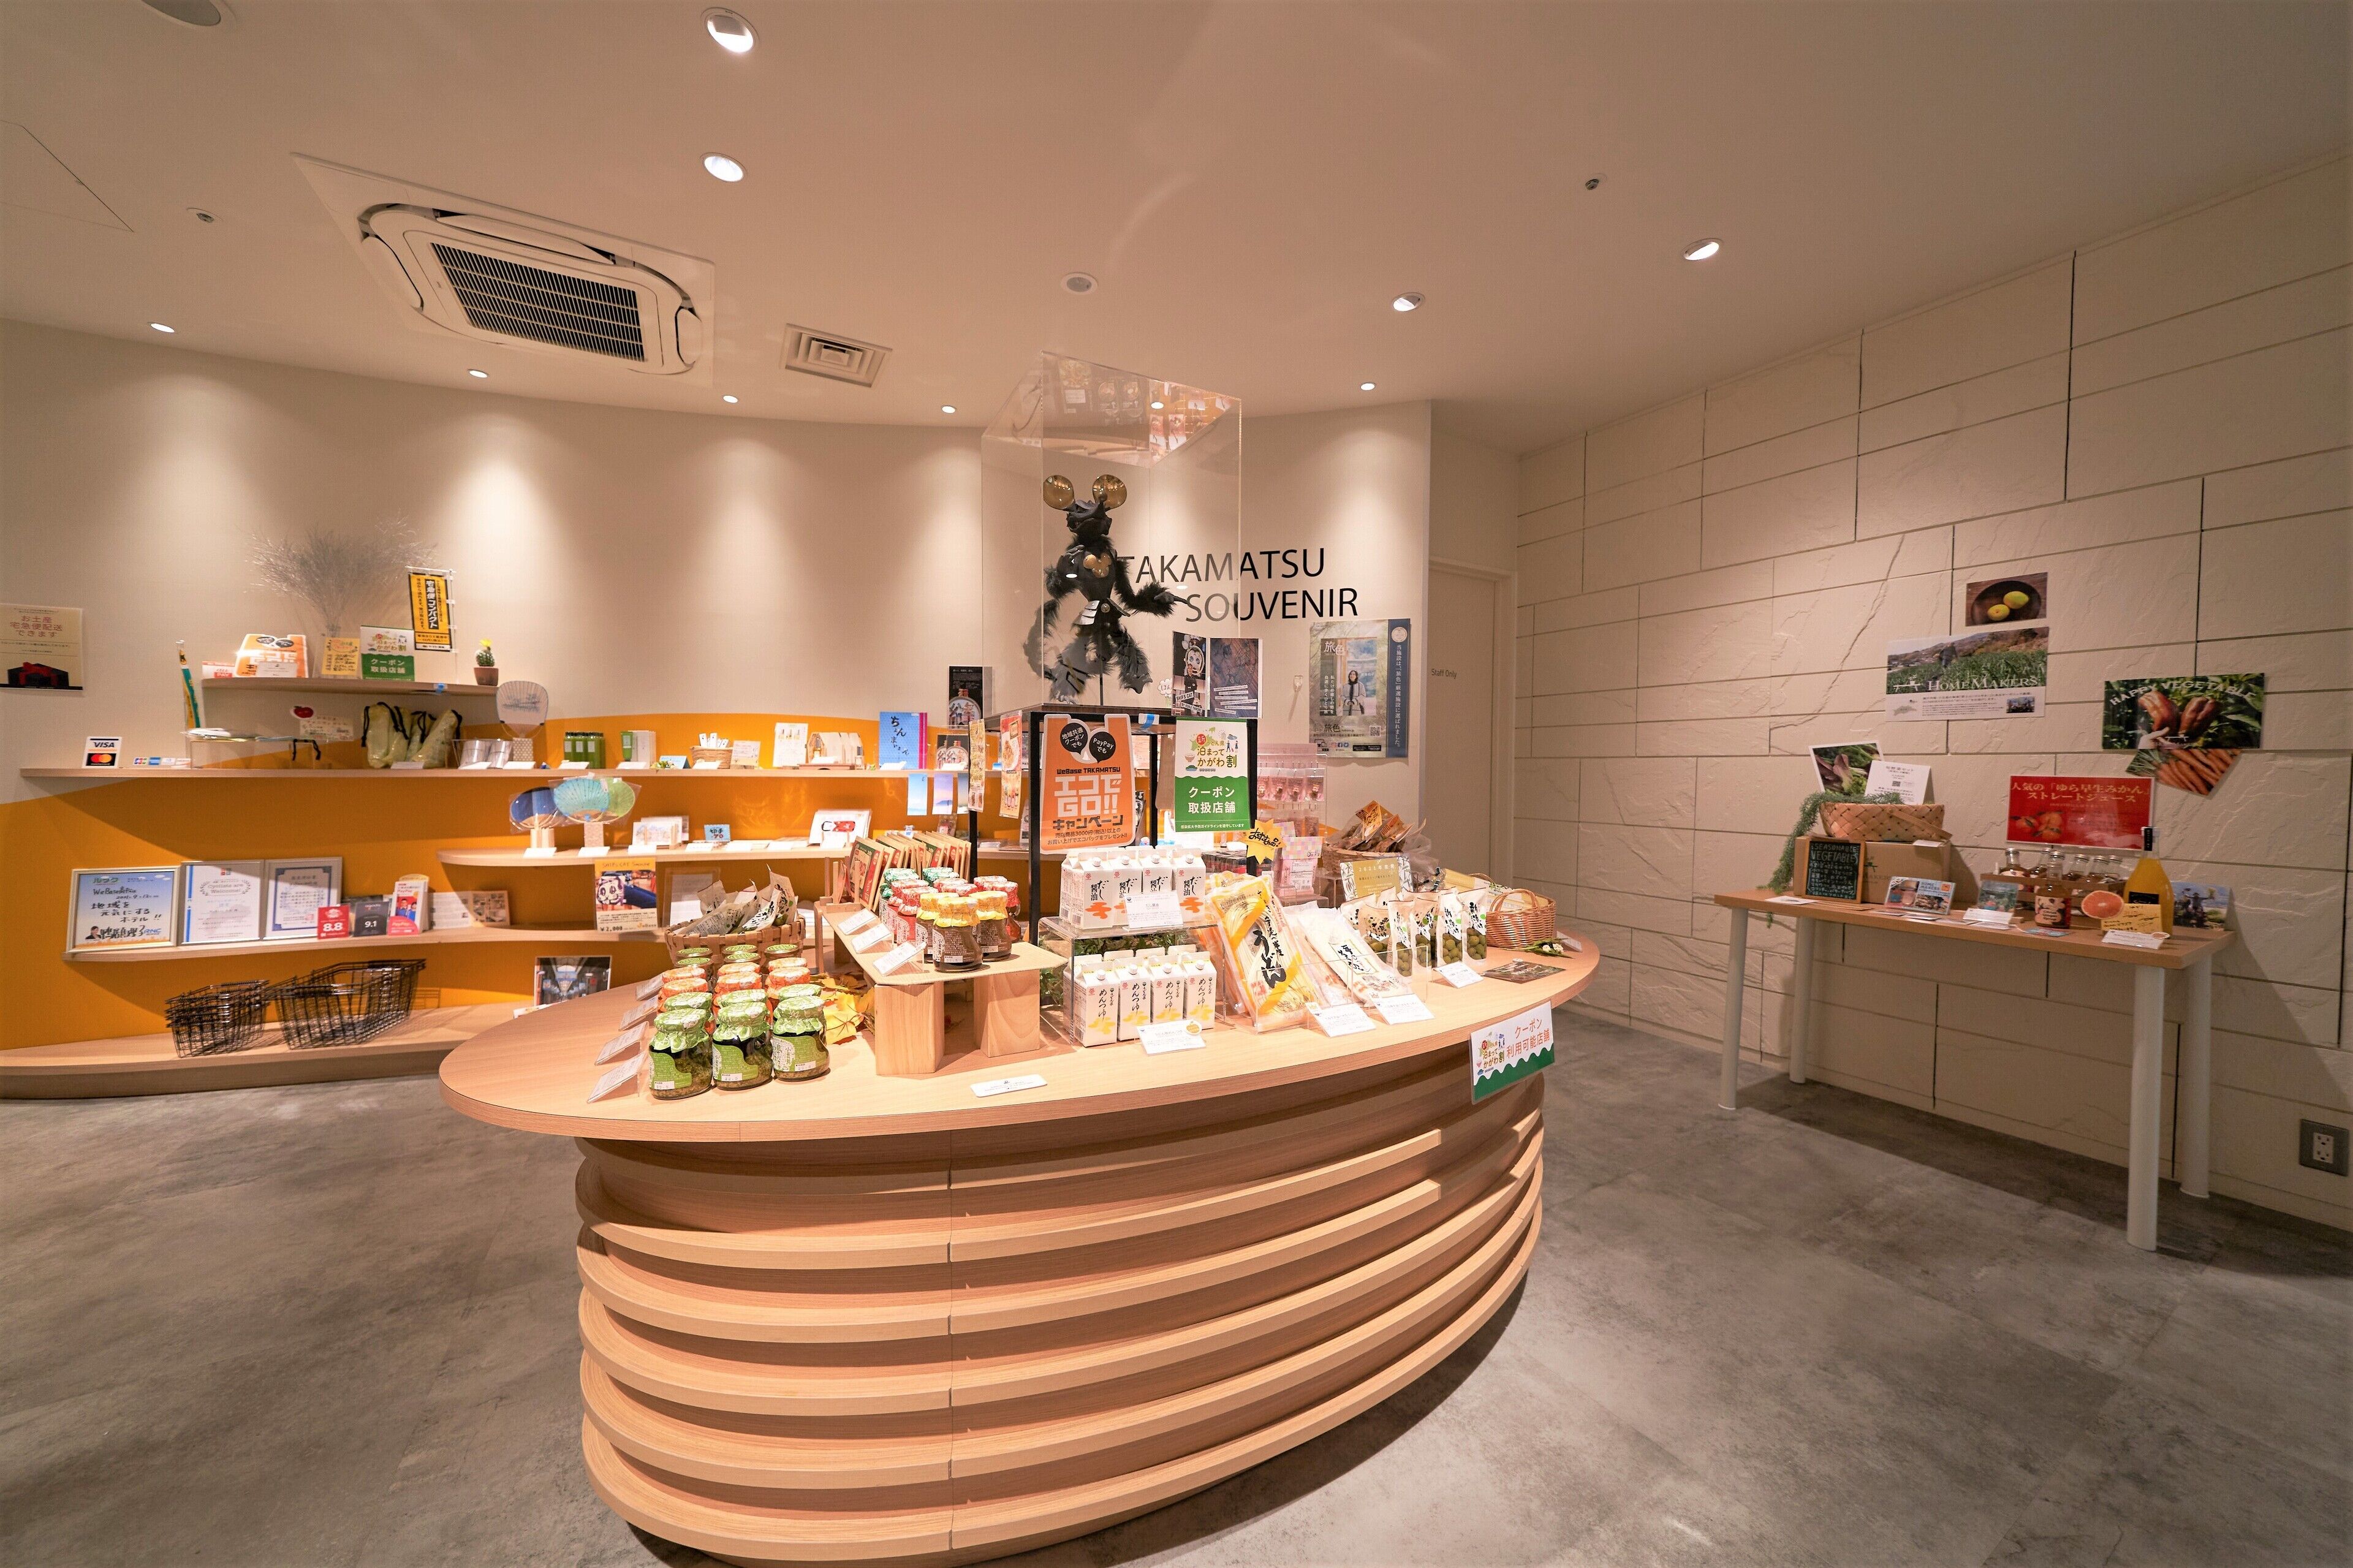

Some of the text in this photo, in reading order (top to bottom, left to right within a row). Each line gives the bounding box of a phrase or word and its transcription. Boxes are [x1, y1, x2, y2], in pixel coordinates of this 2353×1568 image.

[425, 580, 438, 628] 宅急便コンパクト
[1186, 588, 1358, 622] SOUVENIR
[10, 622, 63, 632] 宅急便配送
[1324, 641, 1346, 656] 旅色
[1446, 670, 1457, 679] Only
[2110, 681, 2256, 705] HAPPY VEGETABLE
[1062, 727, 1084, 740] 地域共通
[1324, 724, 1340, 732] 旅色
[1065, 733, 1085, 745] クーポン
[1093, 737, 1114, 750] PayPay
[1197, 746, 1225, 756] 泊まって
[1197, 755, 1237, 768] かがわ割
[1054, 774, 1122, 797] エコで
[1189, 786, 1235, 798] クーポン
[2012, 782, 2150, 795] 人気の「ゆら早生みかん」
[2027, 792, 2137, 803] ストレートジュース
[1057, 794, 1118, 818] GO!!
[1188, 801, 1236, 814] 取扱店舗
[1053, 814, 1124, 831] キャンペーン
[1091, 884, 1098, 901] 醤油
[1097, 880, 1109, 901] だし
[1183, 880, 1191, 896] 醤油
[1191, 876, 1202, 896] だし
[91, 900, 129, 910] 地域を
[101, 908, 150, 917] 元気にする
[323, 922, 343, 932] 8.8
[1252, 929, 1287, 989] うどん
[1165, 981, 1173, 1014] めんつゆ
[1197, 978, 1206, 1010] めんつゆ
[1098, 988, 1107, 1022] めんつゆ
[1515, 1018, 1542, 1039] クーポン
[1506, 1028, 1550, 1059] 利用可能店舗
[1483, 1048, 1498, 1060] 泊まって
[1483, 1050, 1505, 1069] かがわ割
